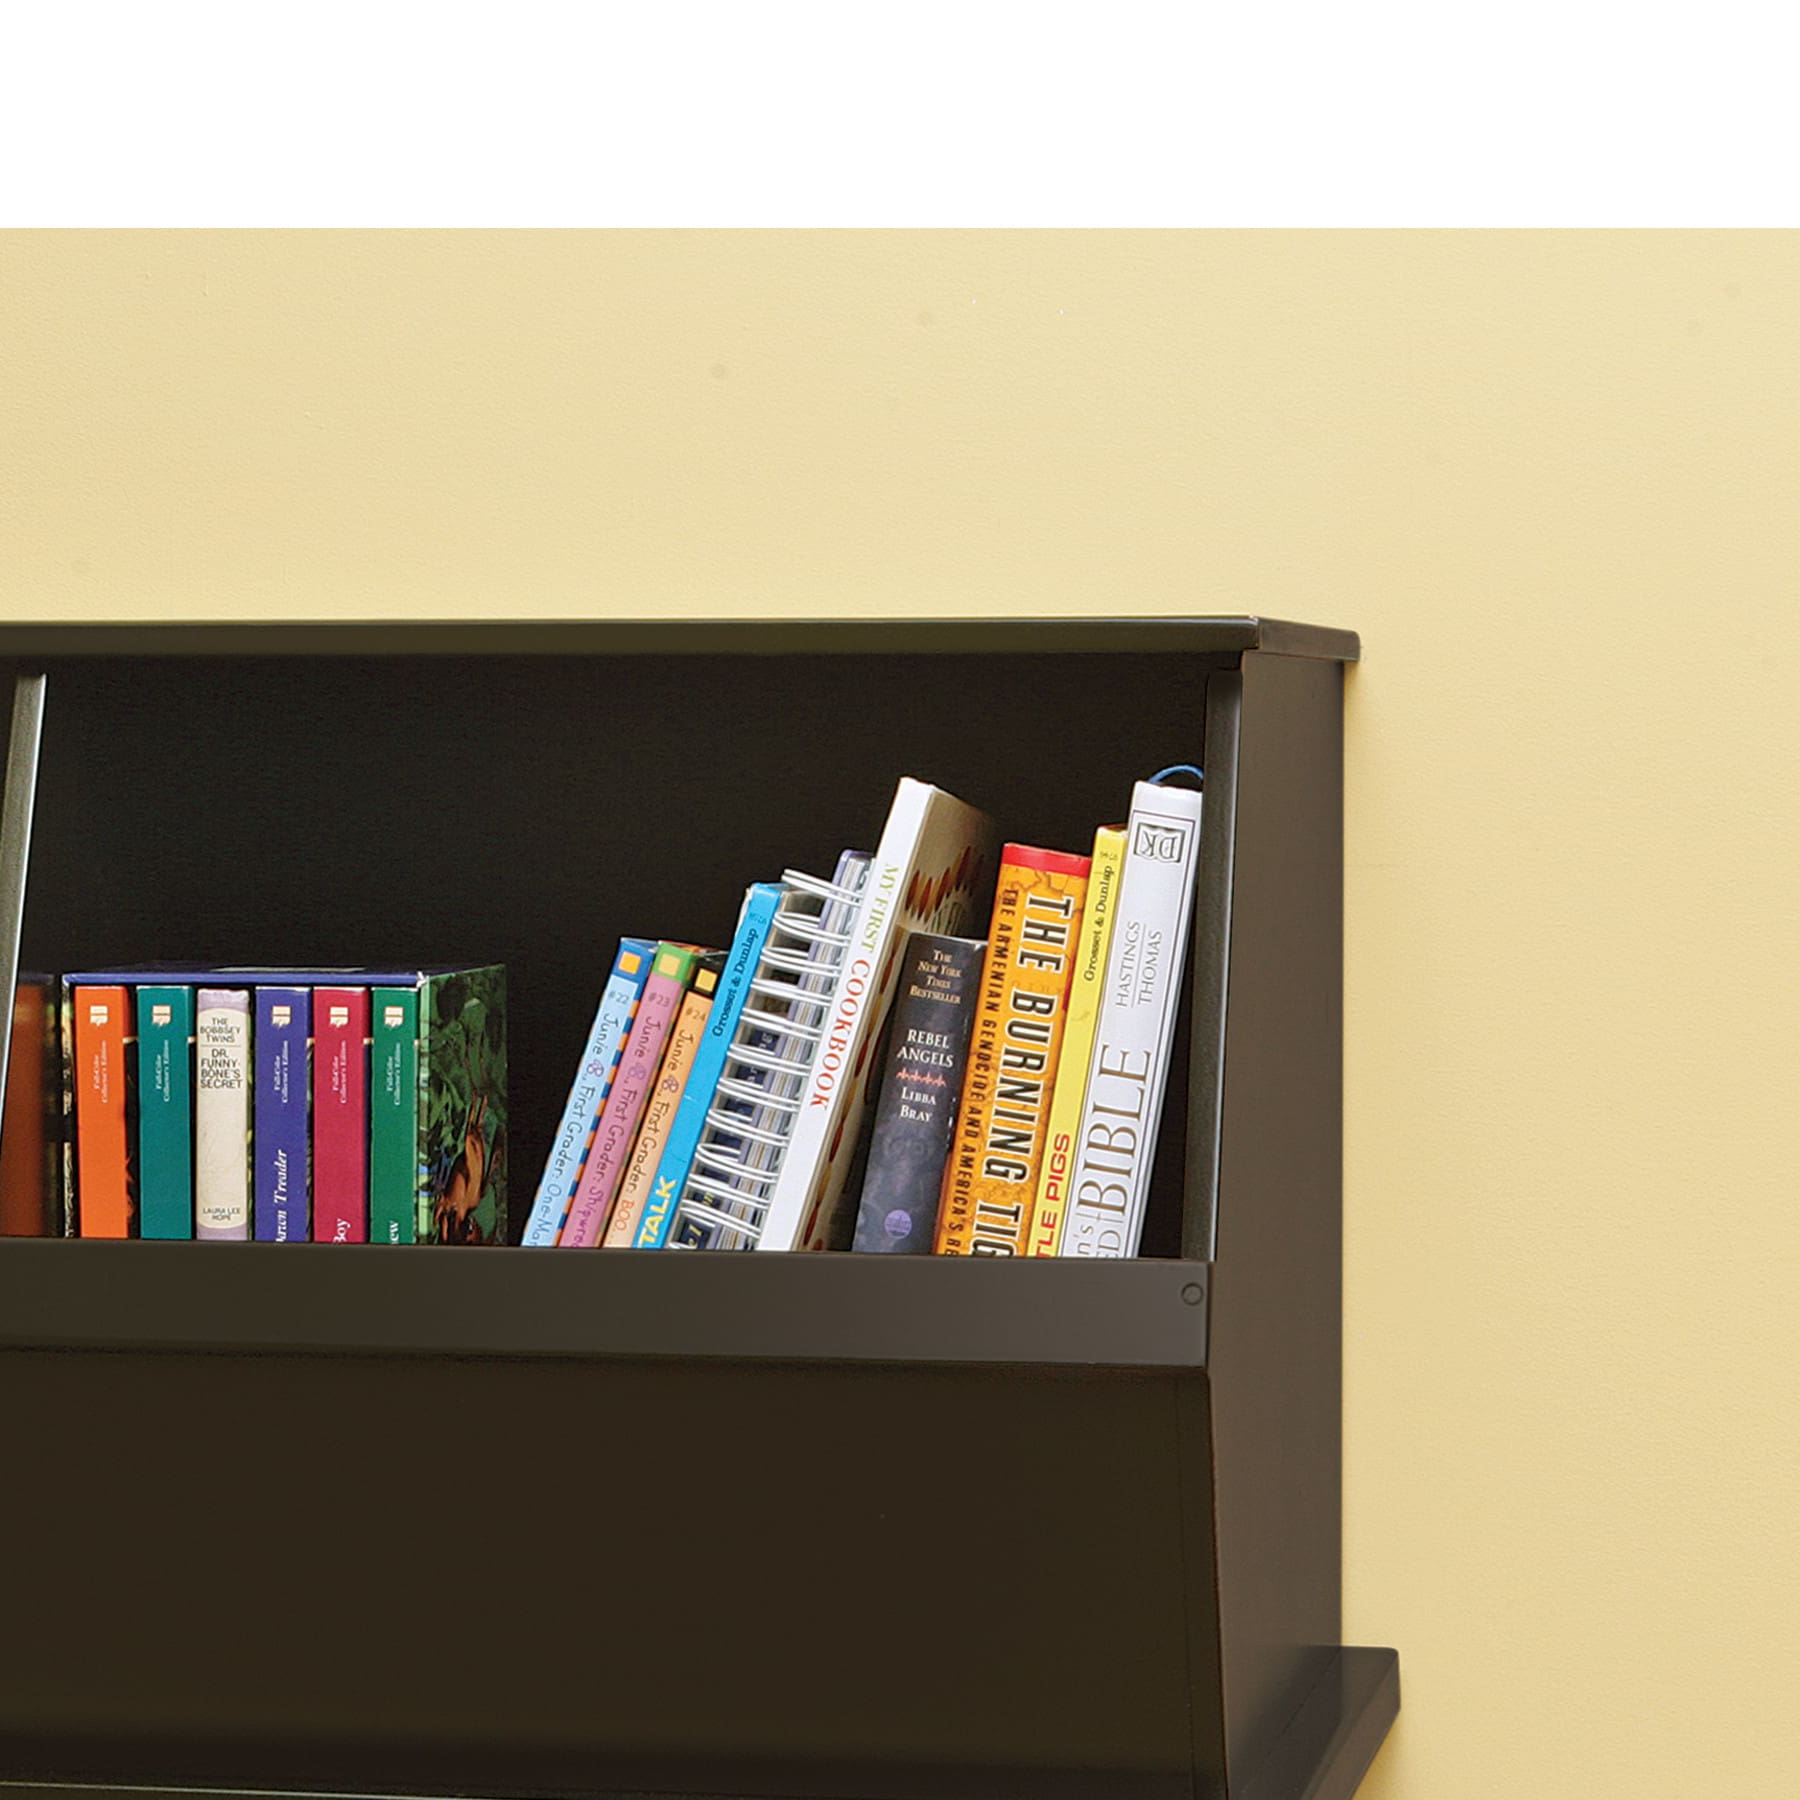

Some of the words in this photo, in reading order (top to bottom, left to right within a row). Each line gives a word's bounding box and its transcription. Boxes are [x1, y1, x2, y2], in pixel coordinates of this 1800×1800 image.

[1142, 830, 1179, 860] DK
[879, 863, 899, 895] MY
[999, 888, 1019, 917] THE
[861, 897, 889, 954] FIRST
[1016, 892, 1075, 975] THE
[1083, 927, 1102, 982] Grosset
[1095, 865, 1115, 914] Dunlap
[711, 988, 738, 1037] Grosset
[734, 927, 759, 974] Dunlap
[984, 922, 1013, 1012] ARMENIAN
[1116, 920, 1141, 1008] HASTINGS
[1137, 930, 1162, 1005] THOMAS
[206, 1034, 235, 1043] TWINS
[211, 1017, 228, 1025] THE
[591, 1013, 619, 1055] Junie
[634, 1015, 662, 1058] Junie
[668, 1028, 696, 1071] Junie
[809, 959, 871, 1110] COOKBOOK
[907, 1028, 950, 1049] REBEL
[199, 1079, 244, 1089] SECRET
[896, 1046, 954, 1068] ANGELS
[969, 1019, 997, 1101] GENOCIDE
[982, 986, 1059, 1185] BURNING
[571, 1084, 596, 1120] First
[613, 1086, 638, 1122] First
[646, 1099, 671, 1135] First
[964, 1105, 982, 1139] AND
[1076, 1044, 1152, 1216] BIBLE
[273, 1149, 288, 1206] Treader
[551, 1120, 583, 1182] Grader:
[594, 1122, 625, 1184] Grader:
[626, 1134, 657, 1194] Grader:
[1045, 1132, 1070, 1202] PIGS
[637, 1175, 677, 1248] TALK
[948, 1143, 977, 1232] AMERICA'S
